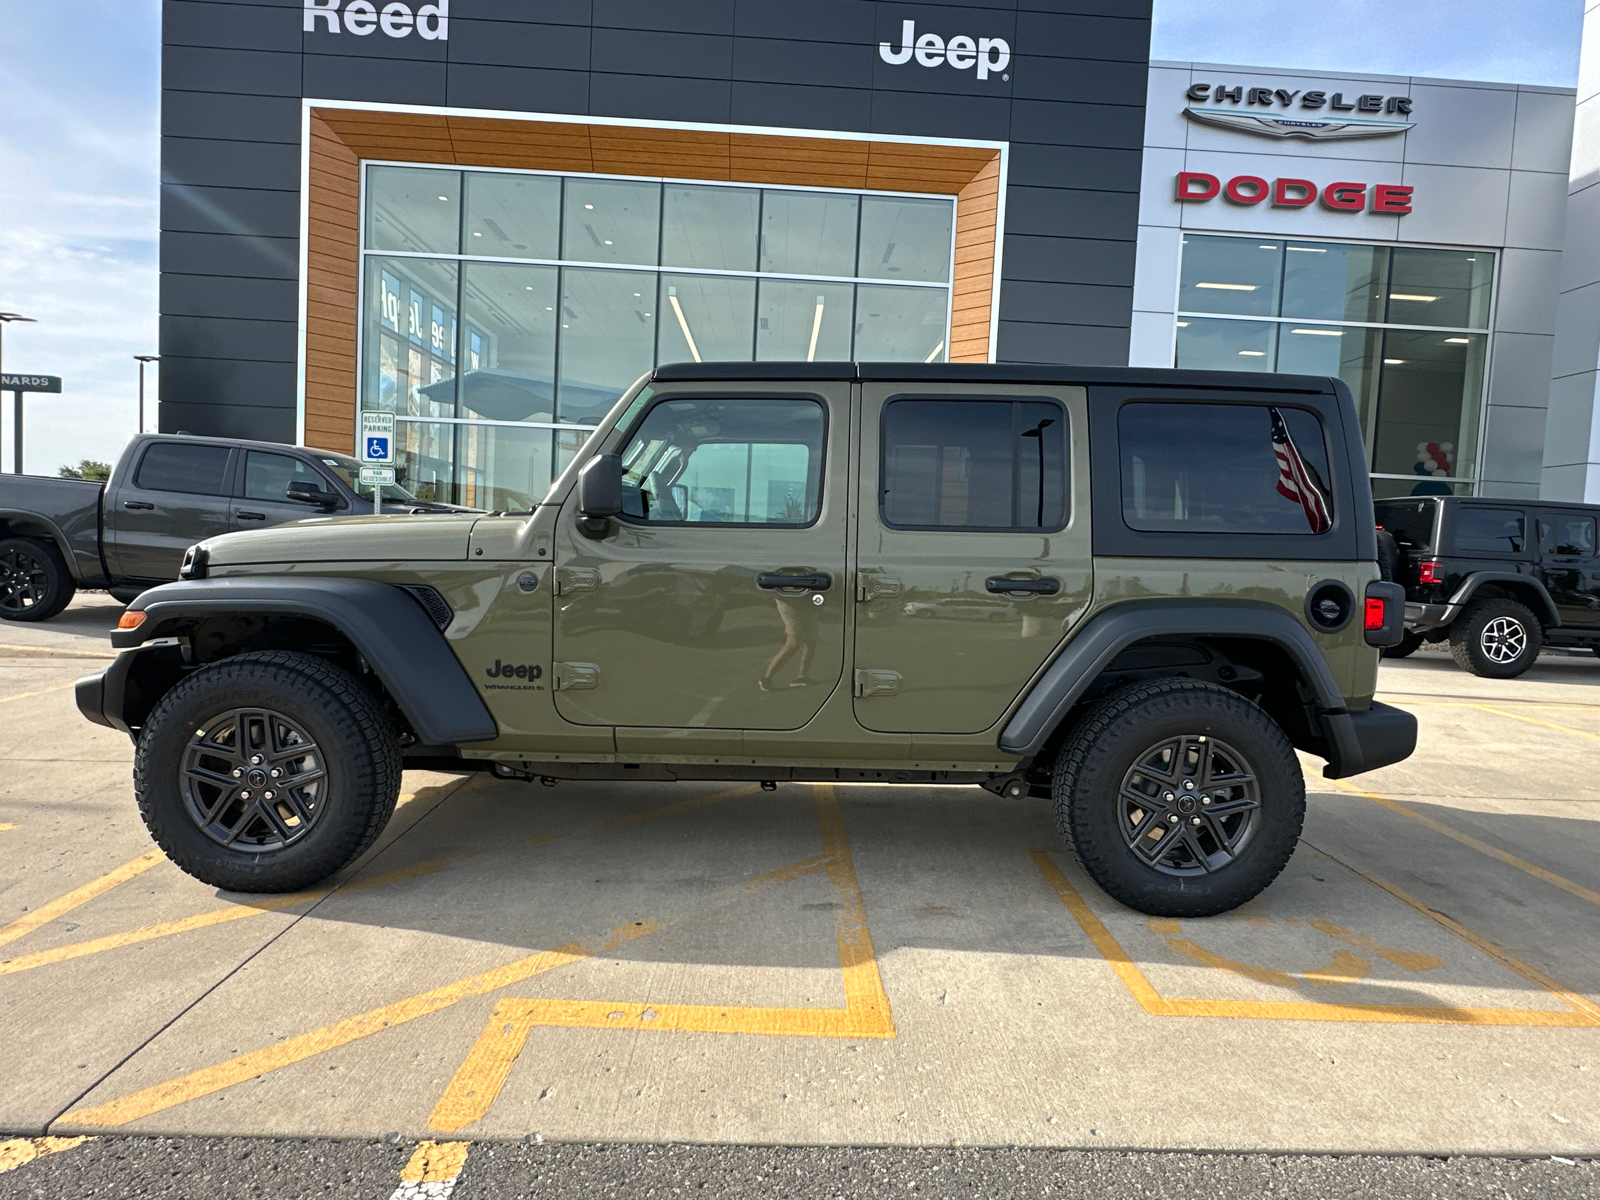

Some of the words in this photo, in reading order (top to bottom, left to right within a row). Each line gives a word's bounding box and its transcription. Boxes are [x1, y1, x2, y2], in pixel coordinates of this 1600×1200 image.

[303, 0, 449, 40] Reed
[879, 19, 1010, 80] Jeep
[1186, 83, 1414, 113] CHRYSLER
[1175, 171, 1414, 216] DODGE
[363, 415, 392, 424] RESERVED
[363, 424, 392, 433] PARKING
[362, 475, 393, 483] ACCESSIBLE
[486, 659, 542, 682] Jeep
